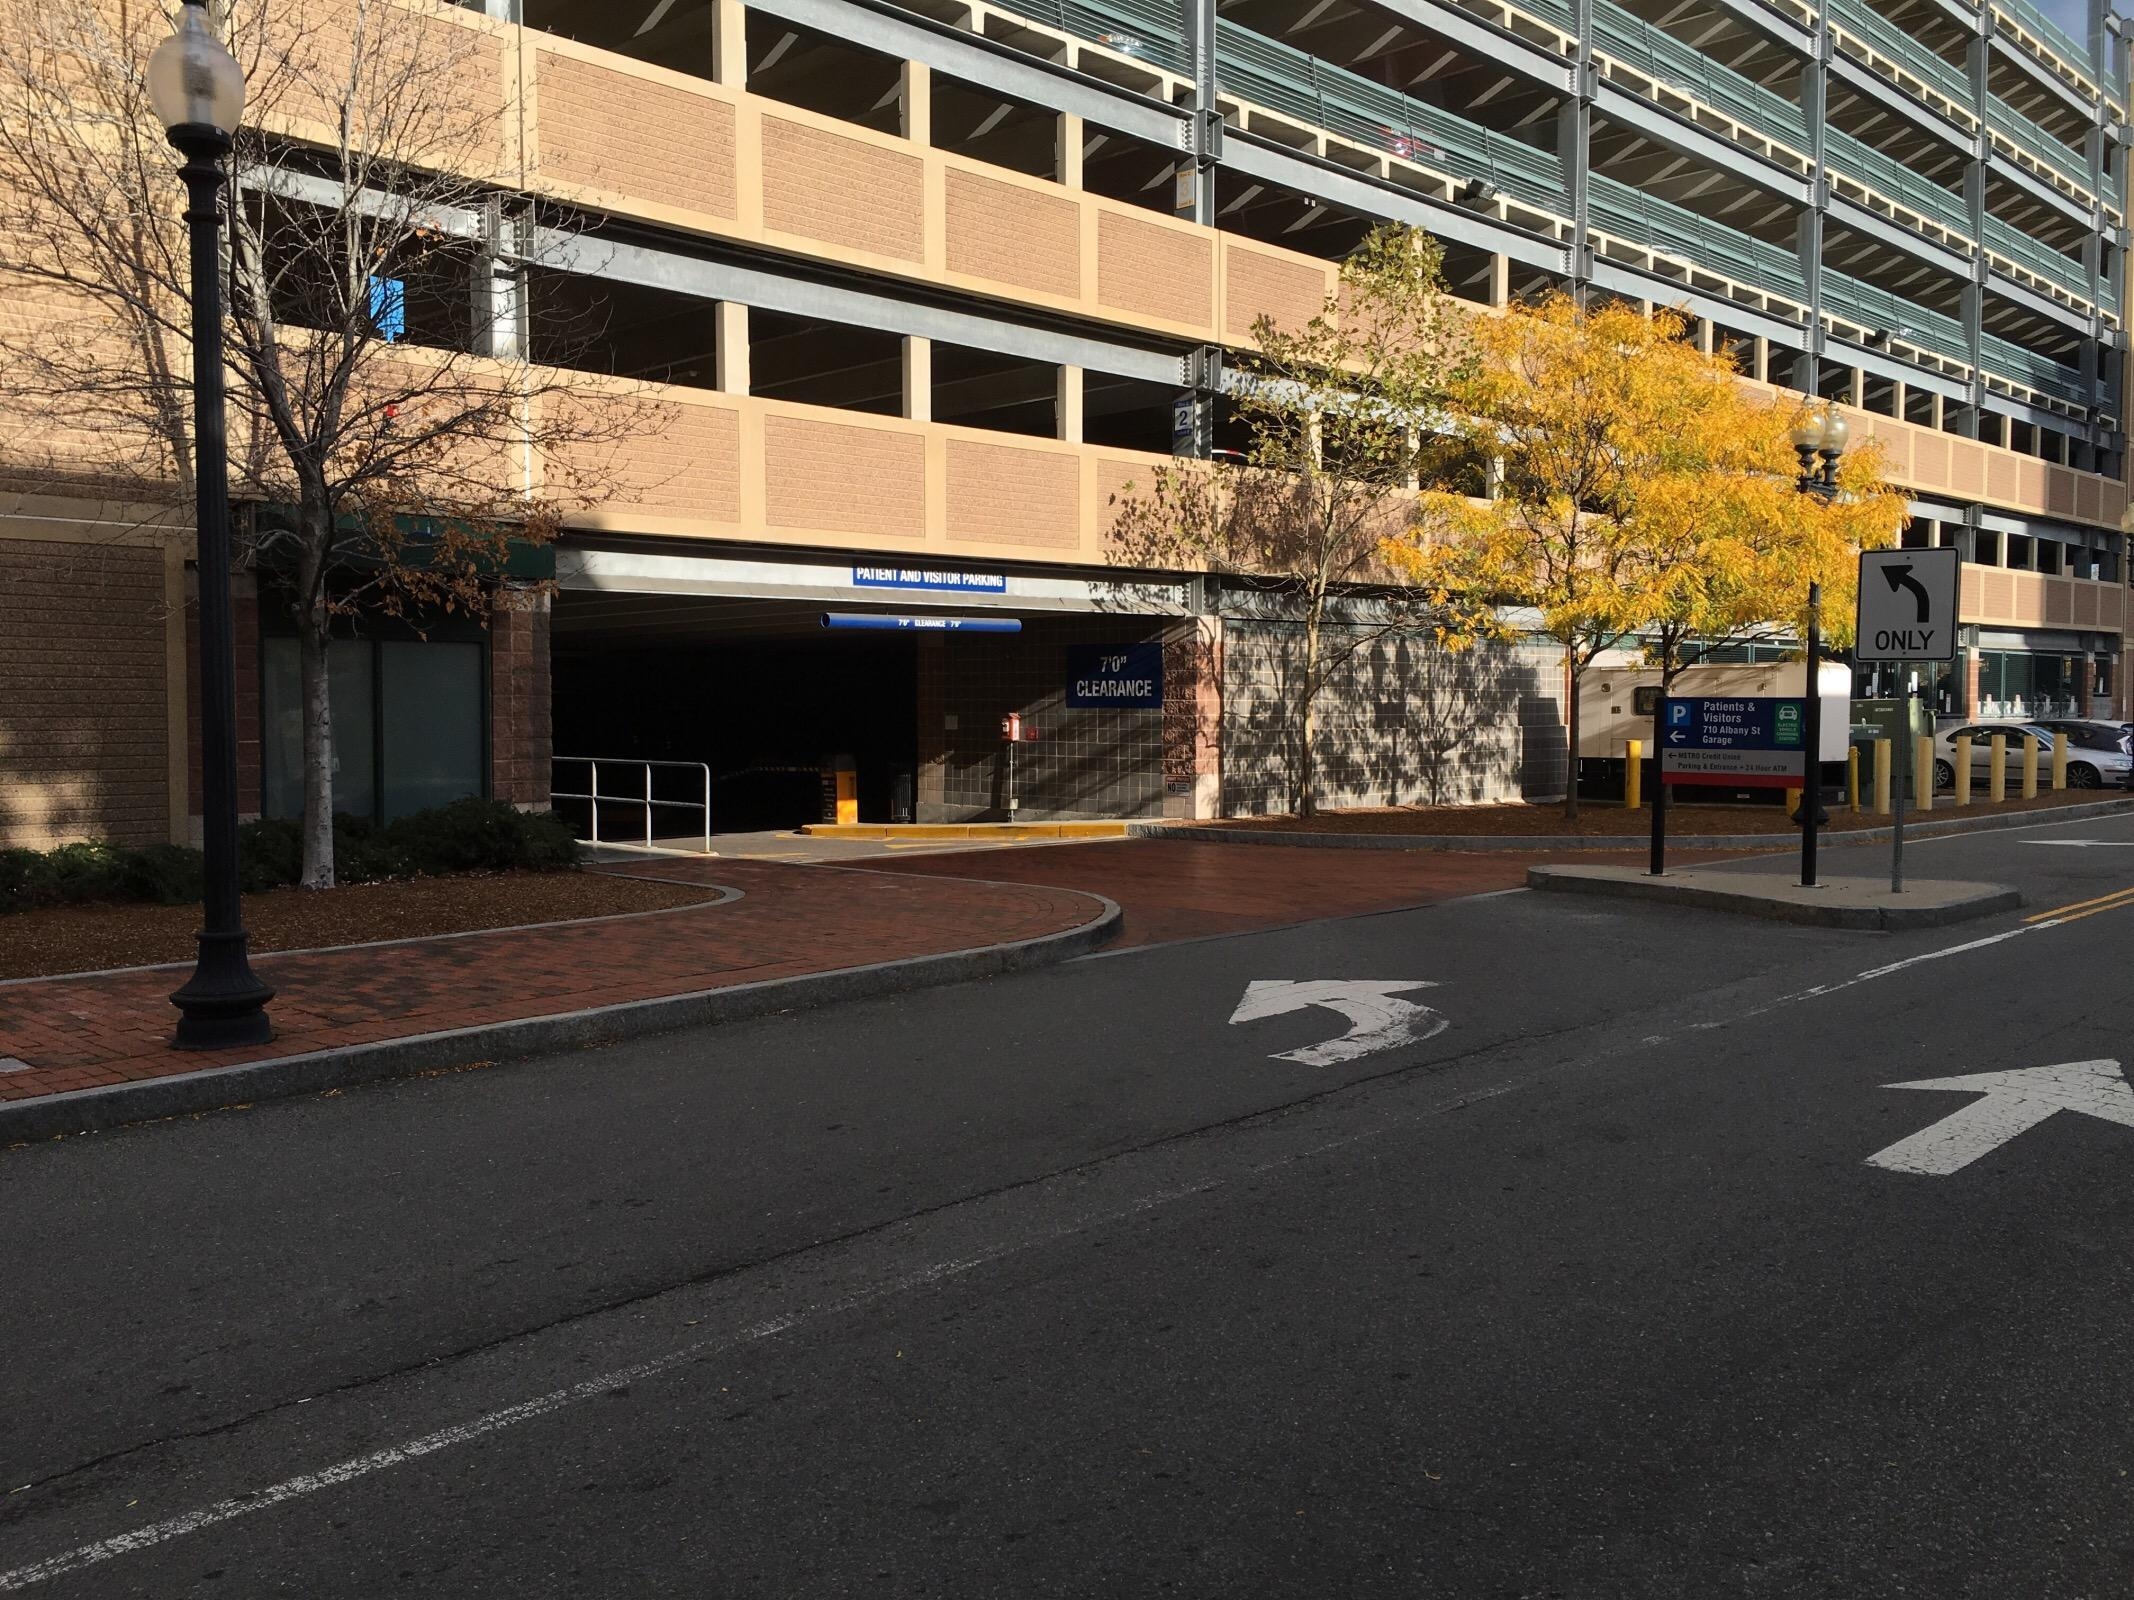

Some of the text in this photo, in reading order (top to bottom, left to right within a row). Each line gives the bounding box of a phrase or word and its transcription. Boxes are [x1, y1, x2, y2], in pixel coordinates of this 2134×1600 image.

[1179, 410, 1188, 426] 2
[856, 566, 1003, 587] PATIENT AND VISITOR PARKING
[914, 619, 946, 628] CLEARANCE
[1875, 630, 1935, 651] ONLY
[1076, 680, 1152, 697] CLEARANCE
[1703, 701, 1756, 712] Patients &
[1673, 705, 1686, 723] P
[1703, 712, 1742, 723] Visitors
[1703, 725, 1761, 736] 710 Albany St
[1702, 735, 1732, 745] Garage
[1701, 752, 1721, 760] Credit
[1677, 762, 1701, 771] Parking
[1709, 763, 1738, 771] Entrance
